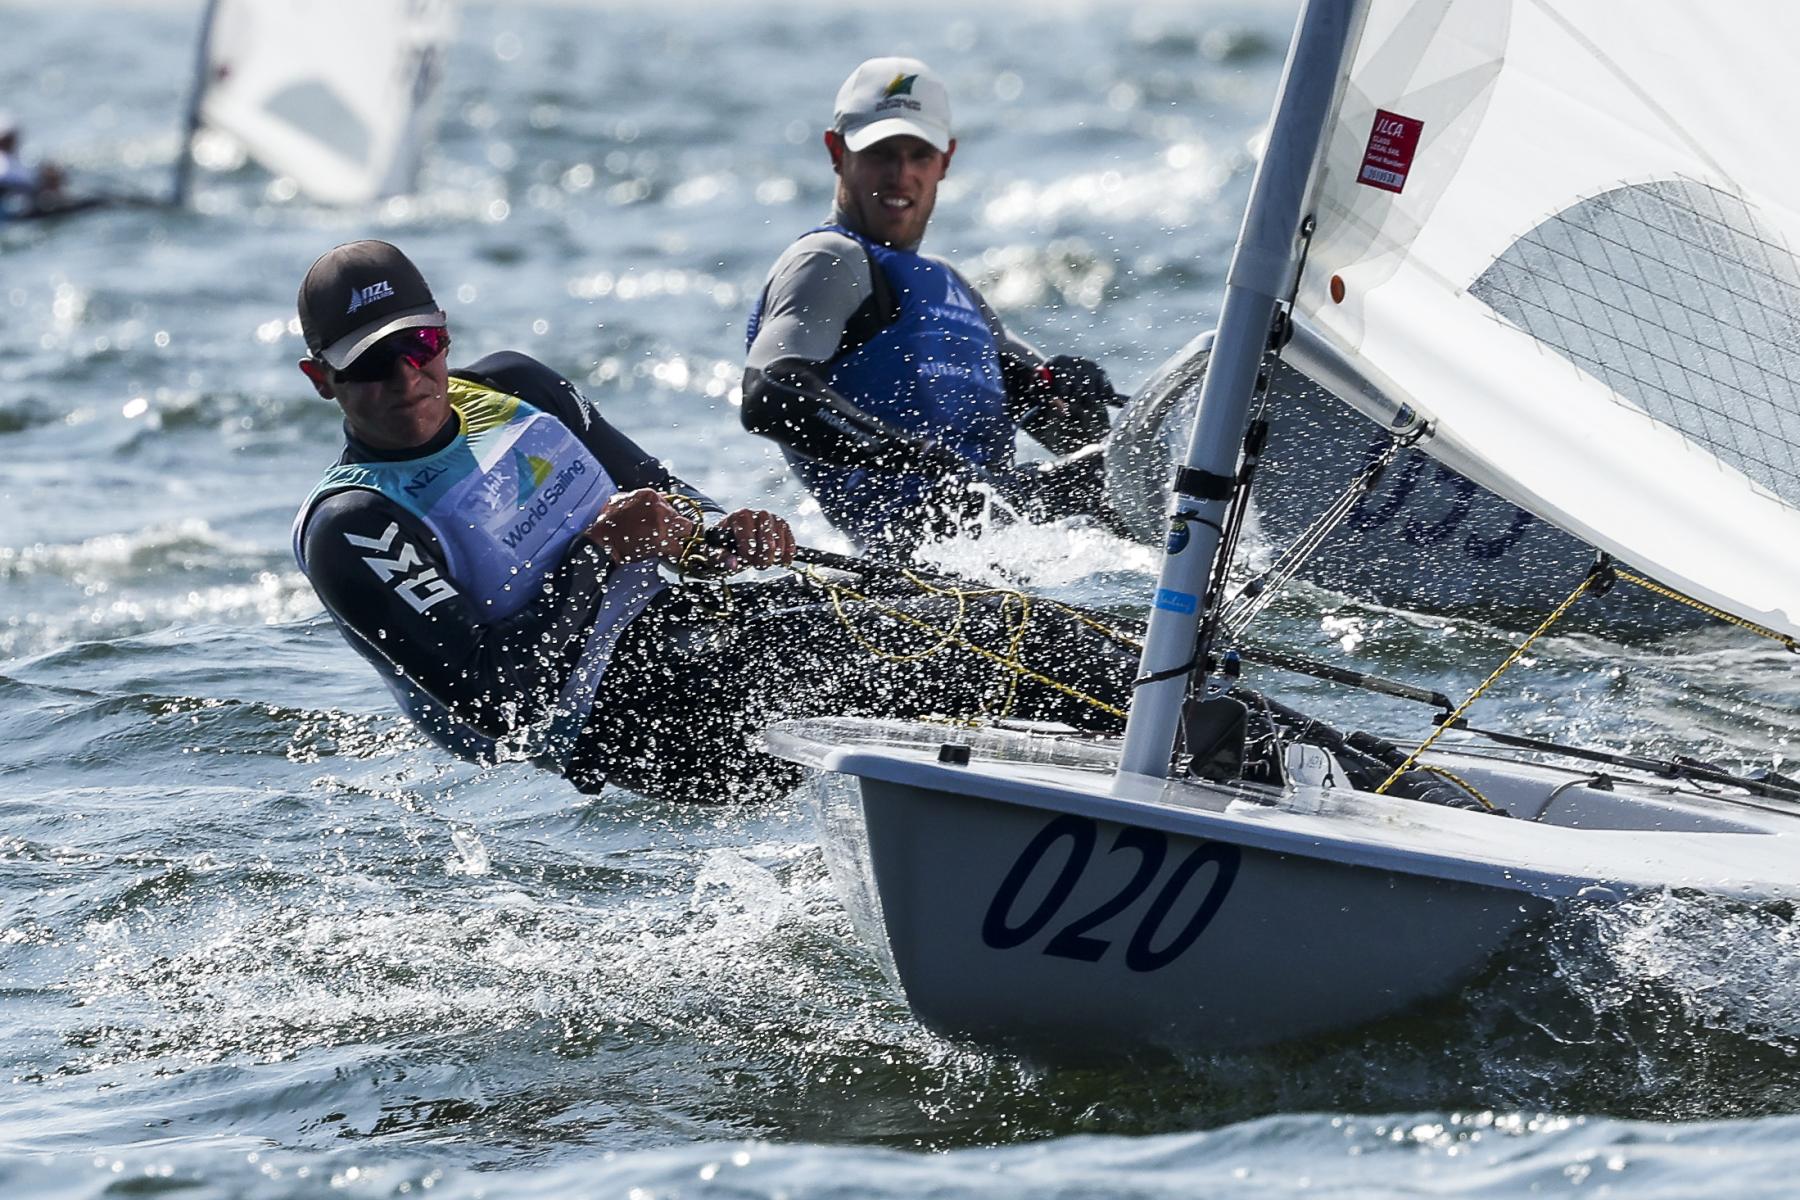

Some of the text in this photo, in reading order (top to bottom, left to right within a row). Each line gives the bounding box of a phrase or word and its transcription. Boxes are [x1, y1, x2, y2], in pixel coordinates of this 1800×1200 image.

[1376, 118, 1404, 137] ILCA
[404, 461, 448, 498] NZL
[502, 502, 549, 548] World
[543, 458, 586, 507] Sailing
[981, 813, 1242, 973] 020
